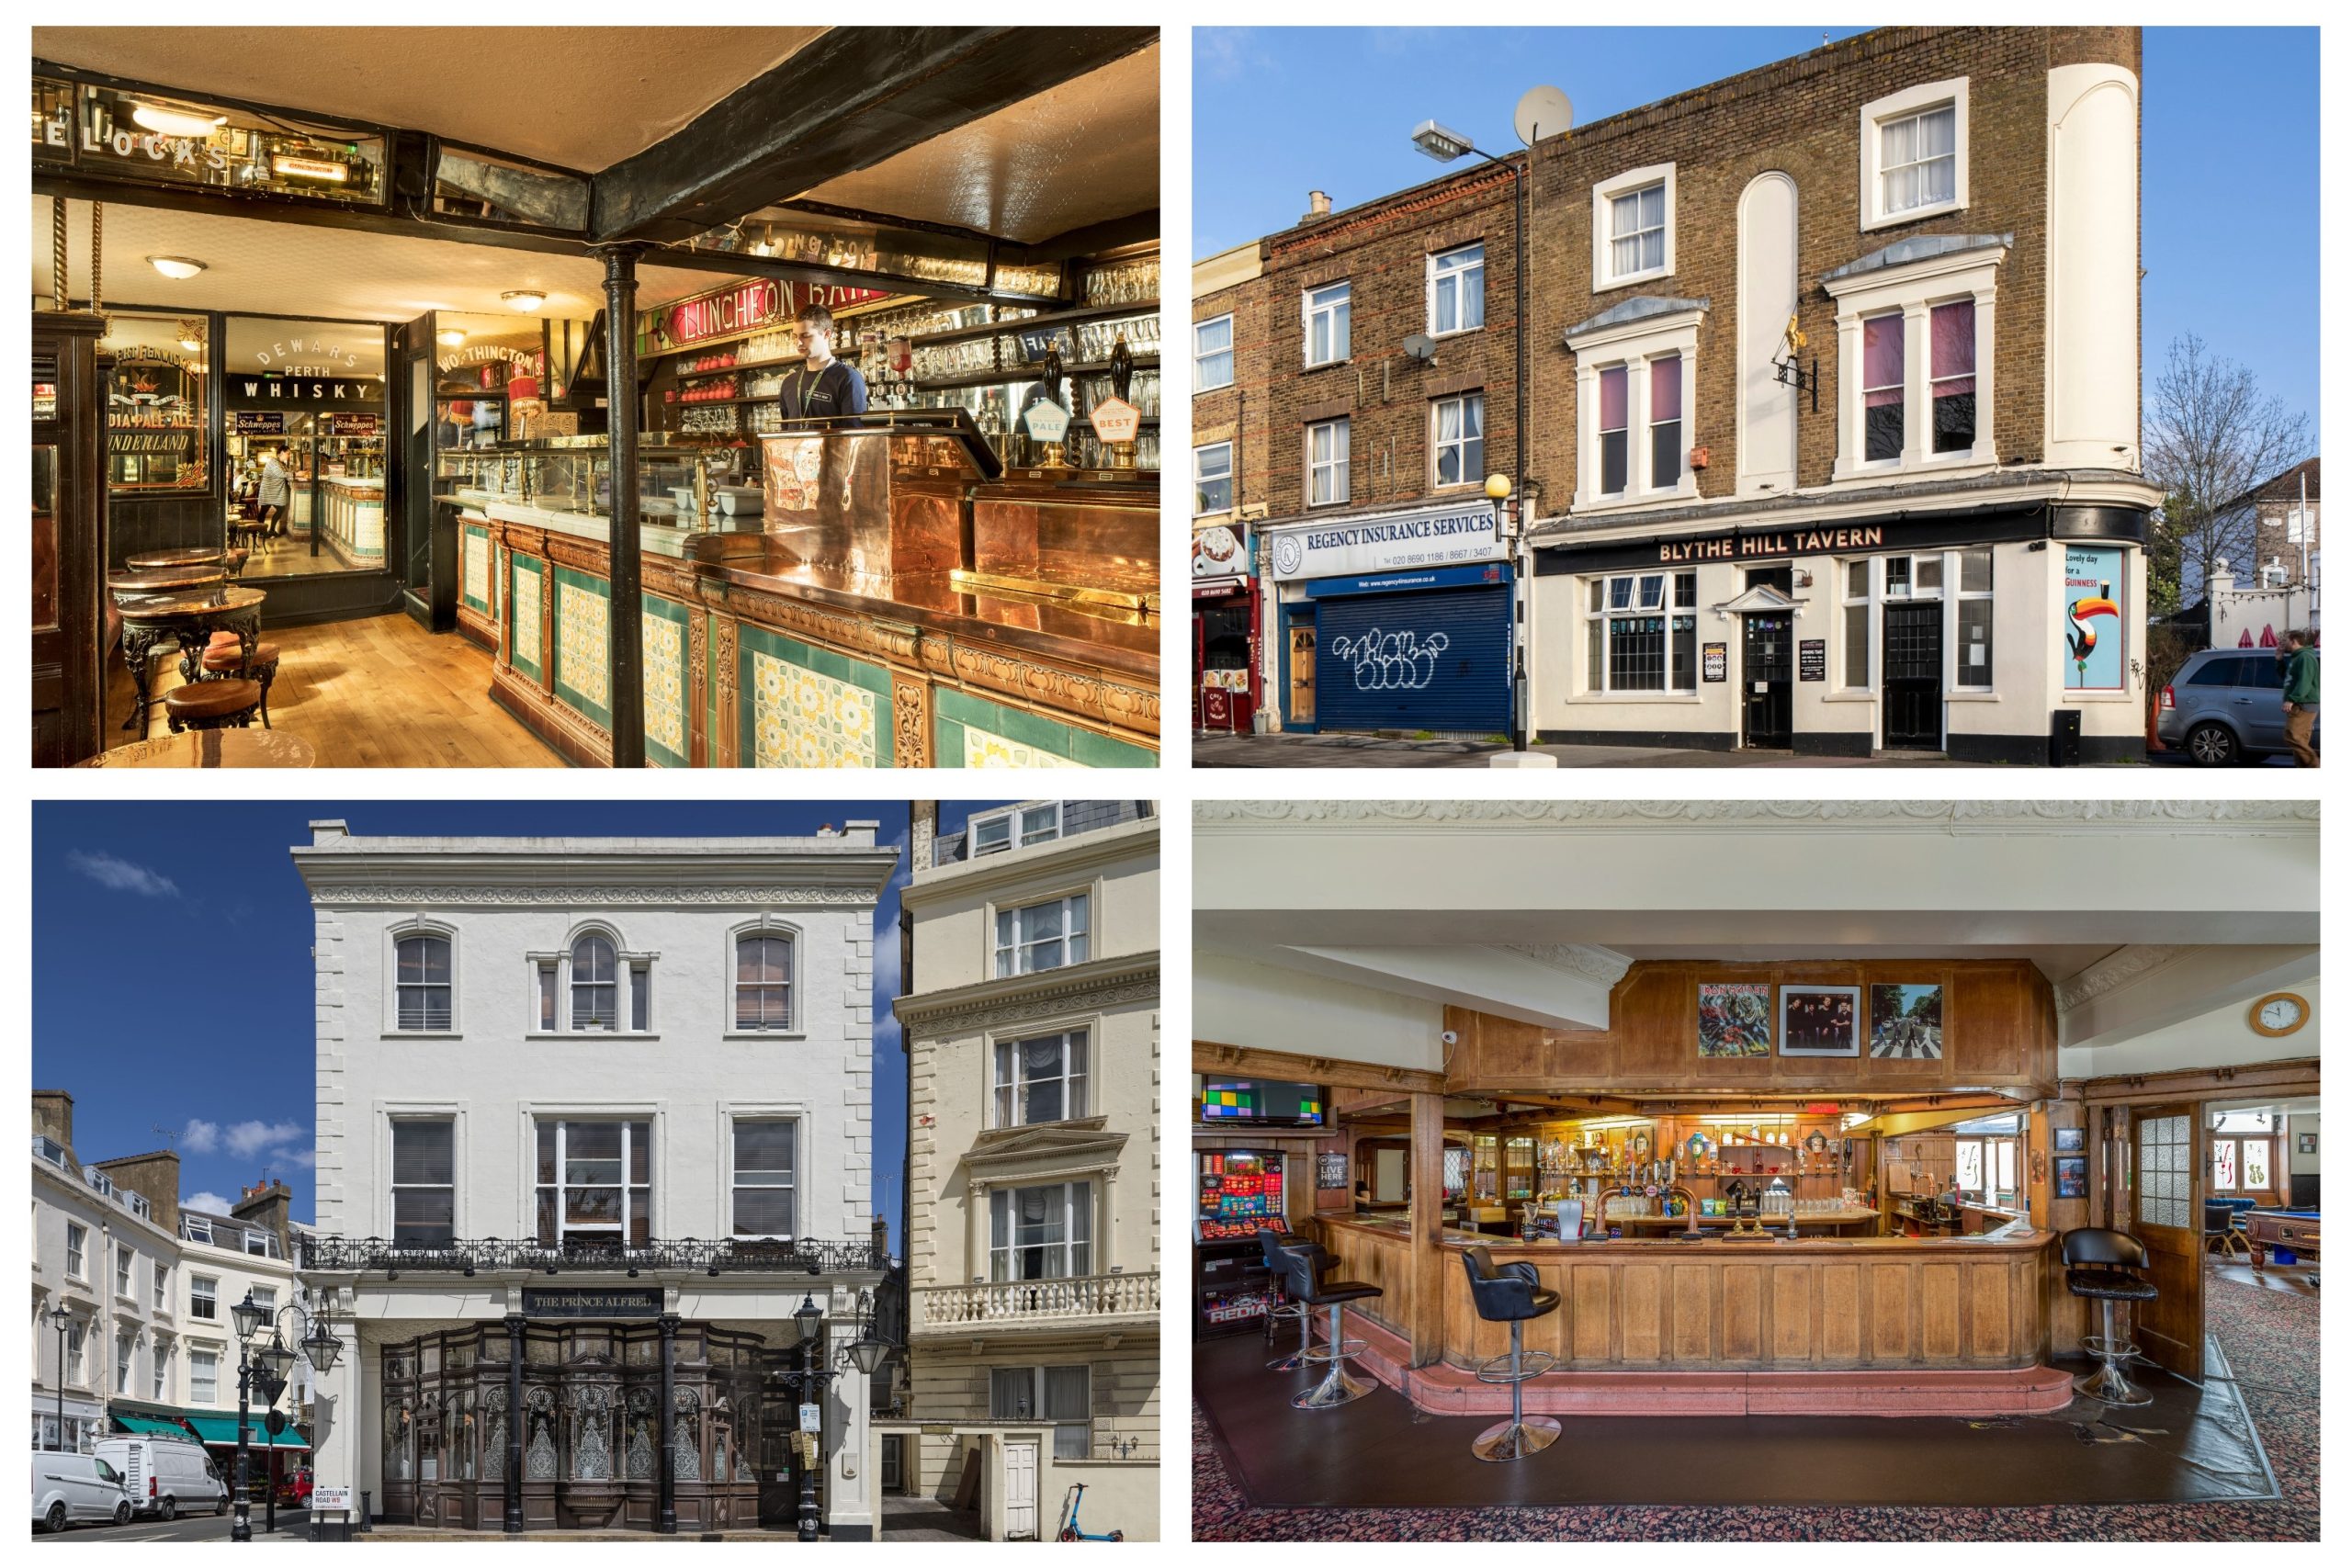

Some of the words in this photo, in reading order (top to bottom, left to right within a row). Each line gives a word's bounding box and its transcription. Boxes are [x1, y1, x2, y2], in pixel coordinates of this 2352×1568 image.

[684, 280, 796, 341] LUNCHEON
[285, 366, 331, 378] PERTH
[244, 382, 368, 399] WHISKY
[134, 413, 166, 429] PALE
[171, 413, 194, 429] ALE
[238, 419, 281, 430] Schweppes
[334, 420, 374, 430] Schweppes
[1099, 418, 1131, 428] BEST
[1032, 423, 1061, 431] PALE
[1307, 529, 1360, 550] REGENCY
[1362, 519, 1431, 544] INSURANCE
[1433, 513, 1494, 536] SERVICES
[1659, 537, 1734, 561] BLYTHE
[1741, 535, 1788, 555] HILL
[1793, 526, 1882, 550] TAVERN
[1392, 556, 1407, 565] 020
[1407, 554, 1425, 564] 8690
[1427, 551, 1444, 562] 1186
[1449, 549, 1468, 559] 8667
[1474, 547, 1493, 558] 3407
[2065, 553, 2085, 564] Lovely
[2086, 553, 2098, 564] day
[2064, 577, 2098, 588] GUINNESS
[1320, 1166, 1343, 1174] LIVE
[535, 1297, 559, 1307] THE
[561, 1297, 604, 1307] PRINCE
[605, 1297, 651, 1307] ALFRED
[1210, 1303, 1268, 1324] REDIA
